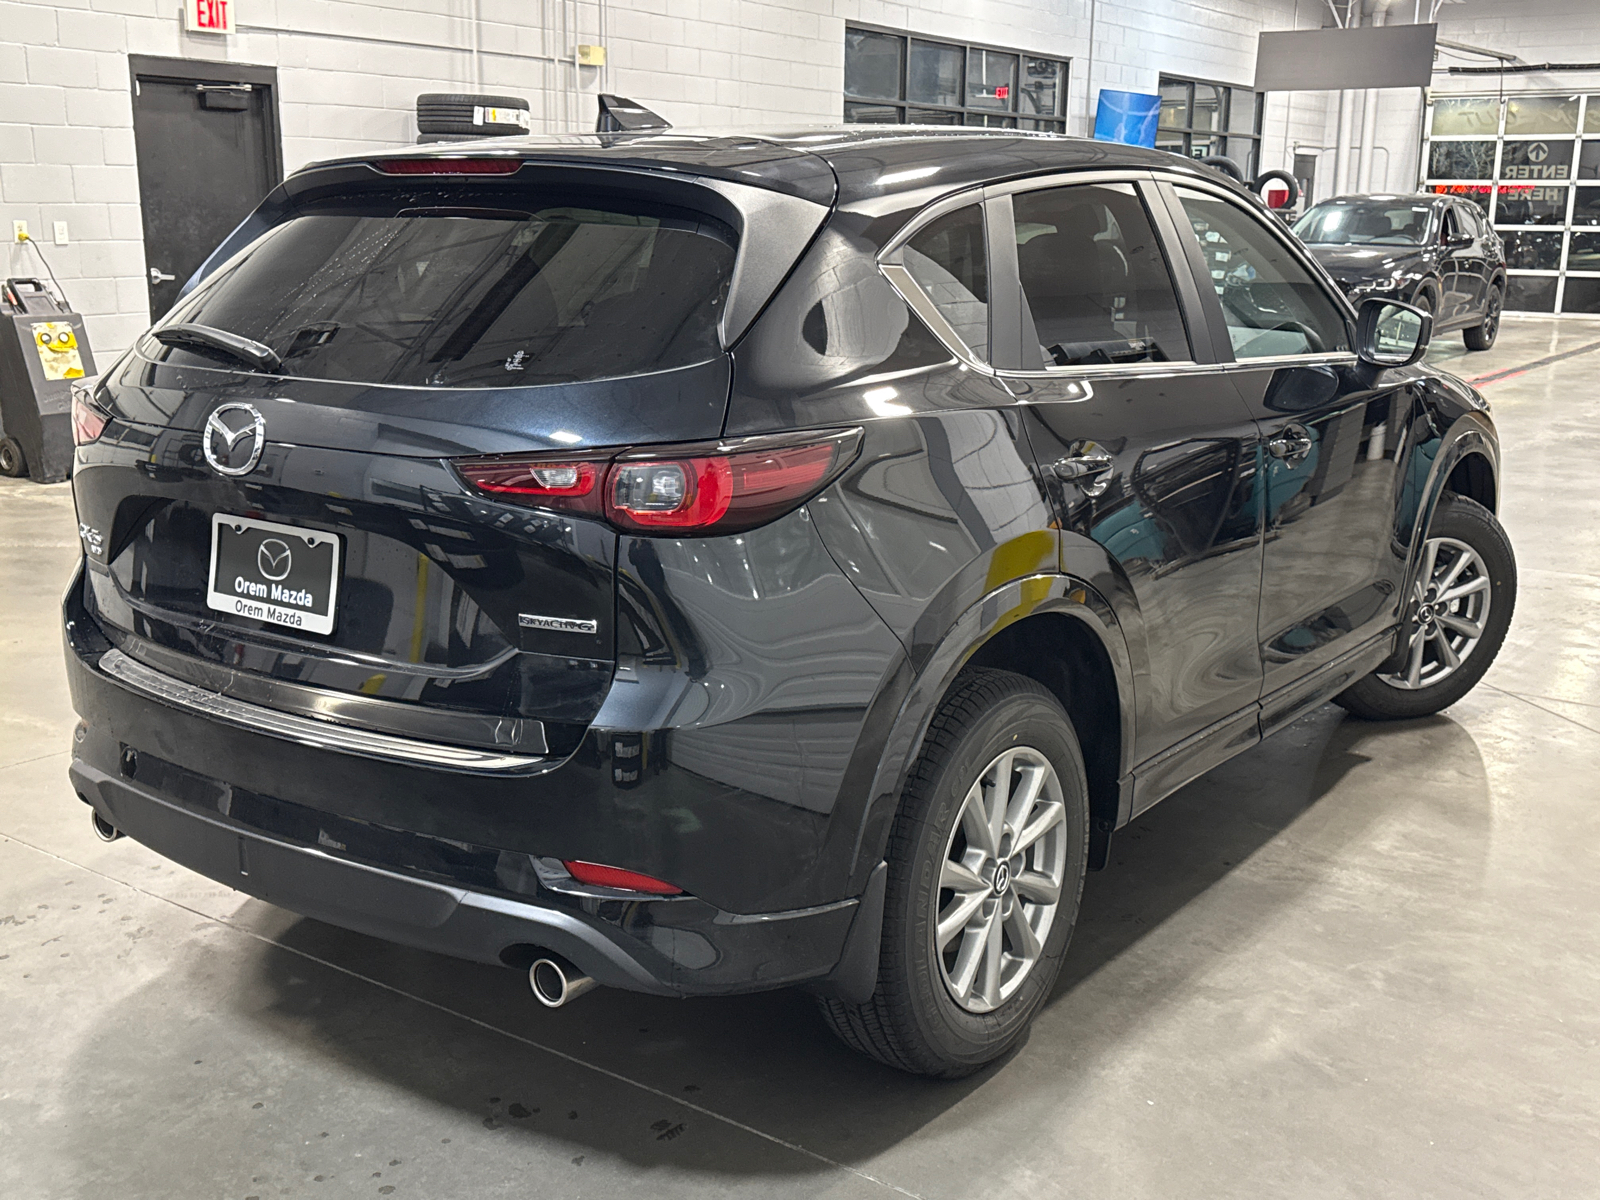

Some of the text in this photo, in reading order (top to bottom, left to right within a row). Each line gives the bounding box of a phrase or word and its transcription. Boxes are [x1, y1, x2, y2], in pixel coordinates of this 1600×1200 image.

[196, 0, 228, 30] EXIT
[234, 576, 313, 608] Orem Mazda
[235, 599, 302, 627] Orem Mazda
